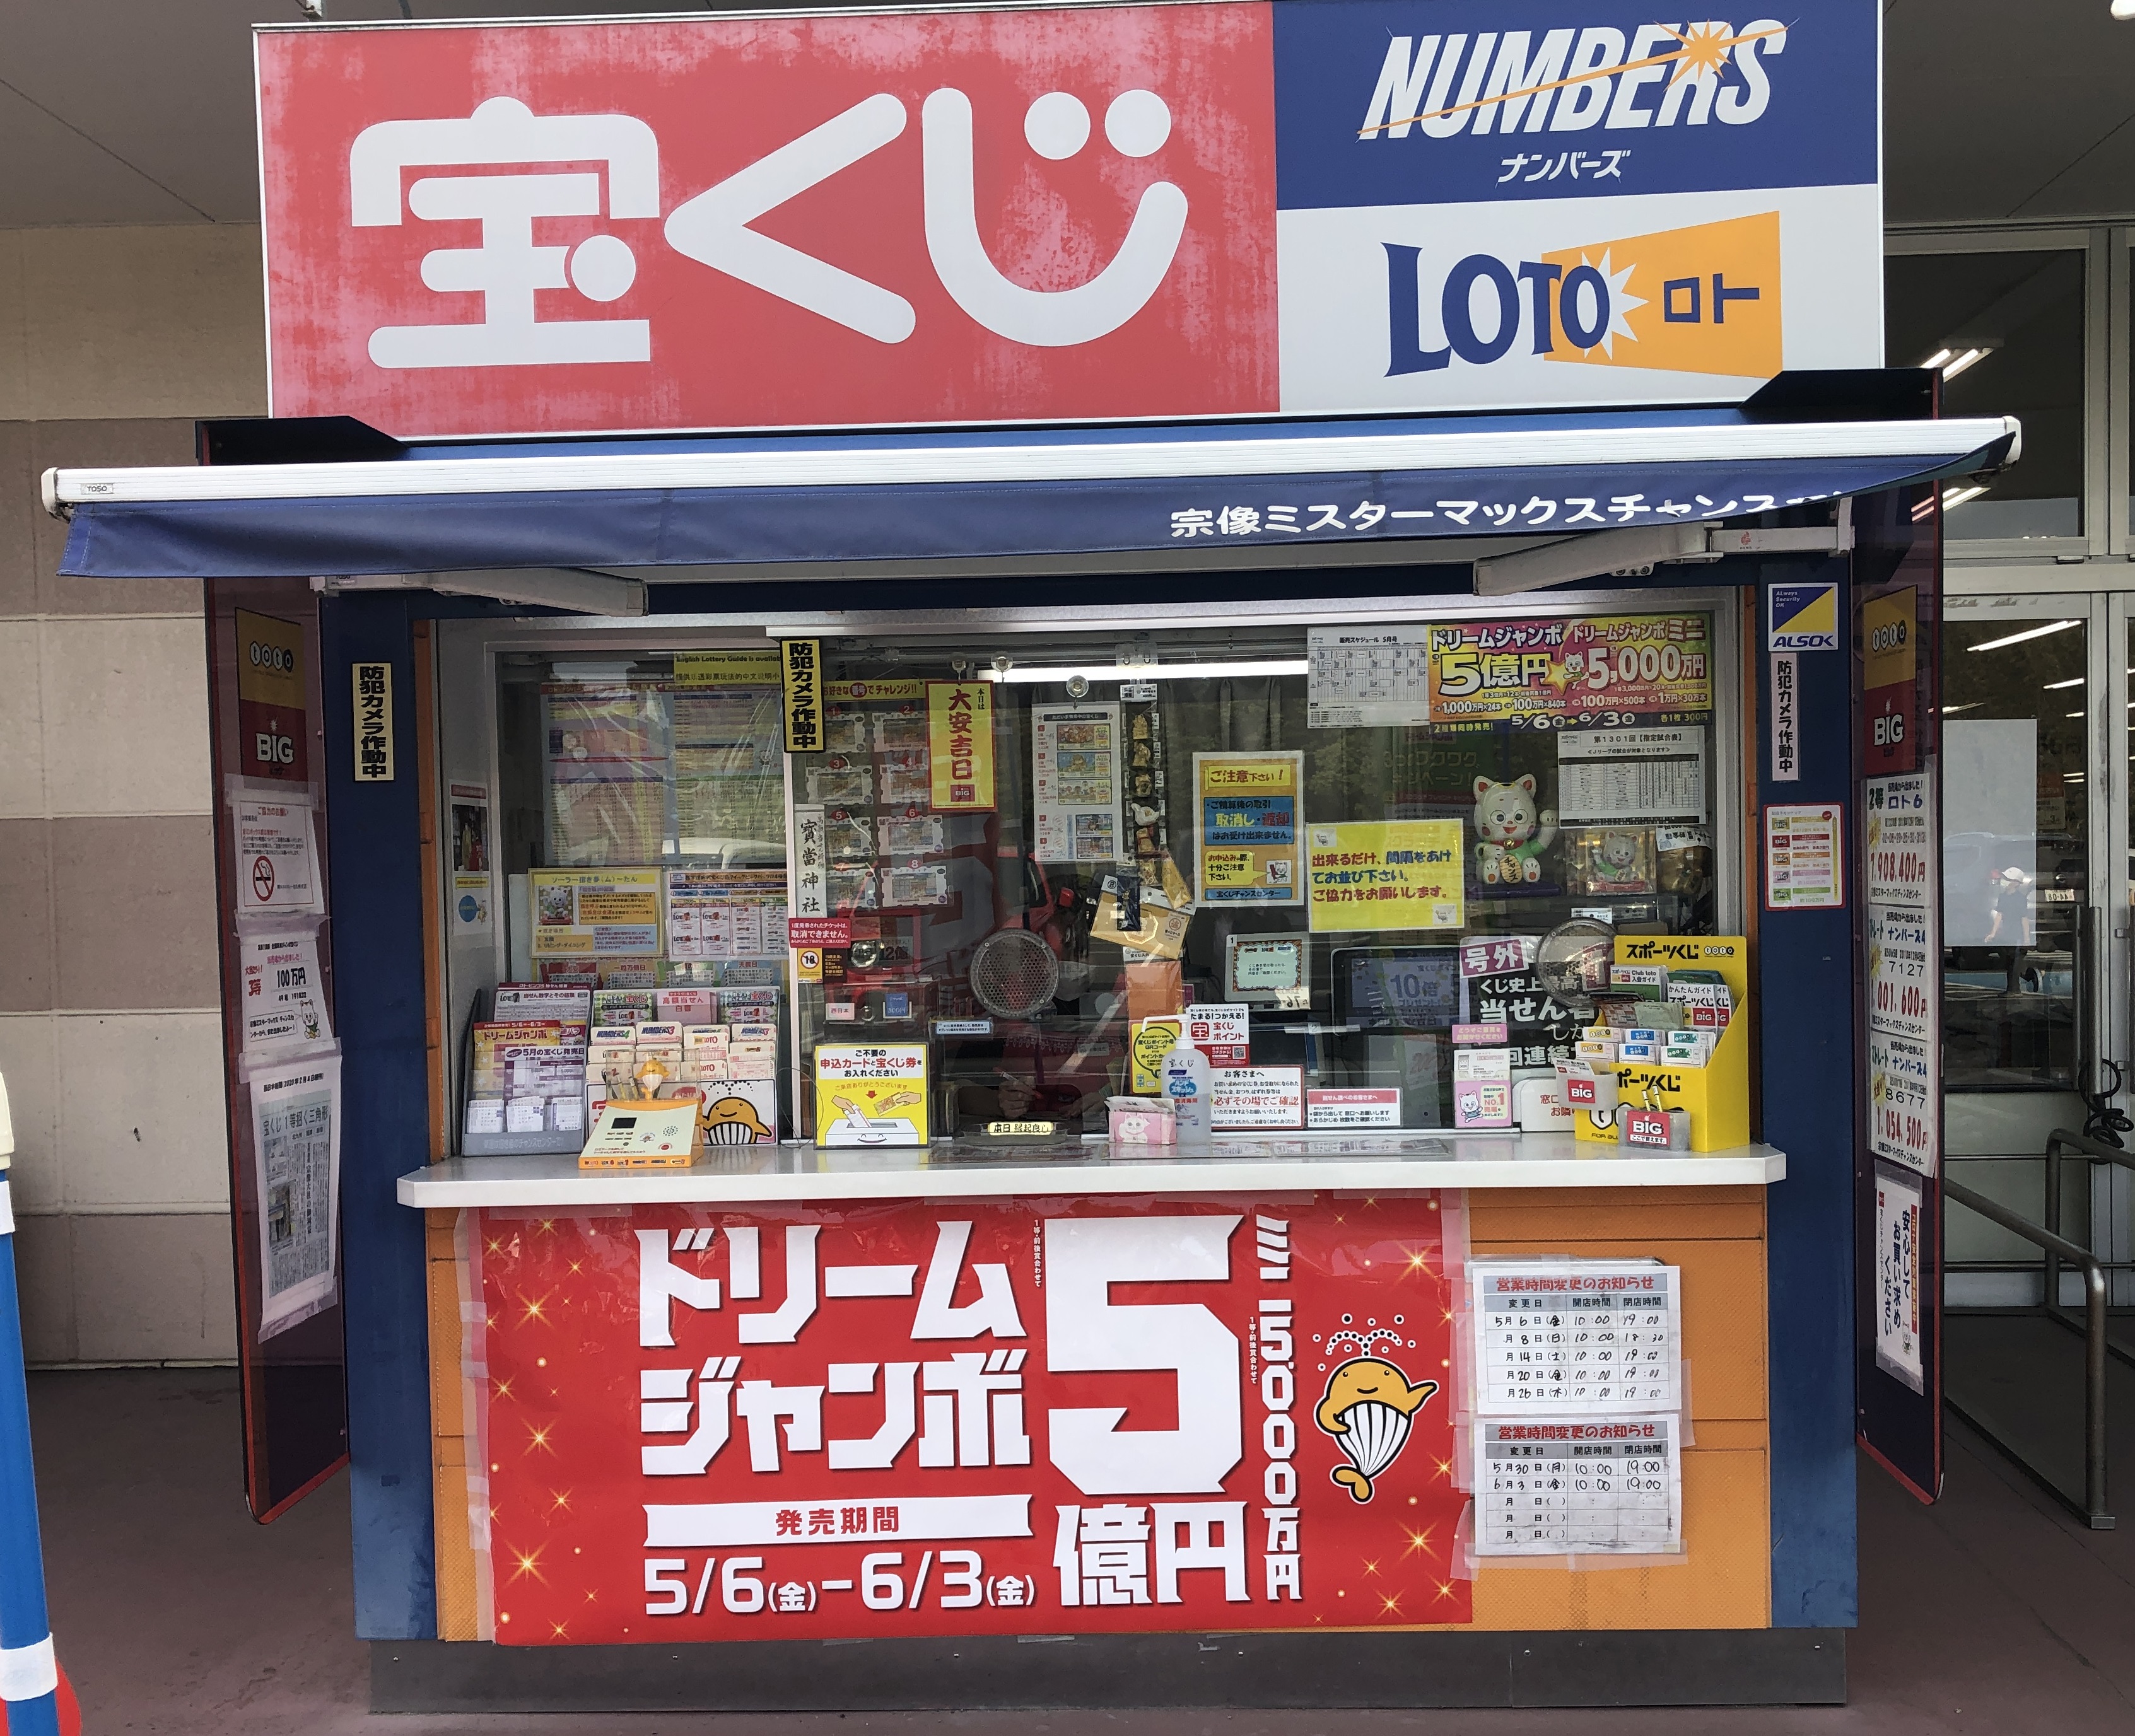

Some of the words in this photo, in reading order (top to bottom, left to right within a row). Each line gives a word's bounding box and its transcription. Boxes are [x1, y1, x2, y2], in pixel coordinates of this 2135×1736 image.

[1359, 19, 1789, 141] NUMBERS
[1499, 149, 1632, 183] ナンバーズ
[350, 87, 1189, 368] 宝くじ
[1663, 274, 1760, 324] ロト
[1383, 242, 1611, 377] LOTO
[1171, 493, 1842, 538] 宗像ミスターマックスチャンス
[1432, 624, 1563, 651] ドリームジャンボ
[1573, 619, 1704, 643] ドリームジャンボミニ
[1772, 635, 1834, 648] ALSOK
[1439, 651, 1552, 696] 5億円
[1588, 644, 1704, 689] 5,000万円
[789, 643, 816, 749] 防犯カメラ作動中
[977, 688, 985, 710] 本日は
[904, 706, 910, 714] 2
[1777, 660, 1794, 773] 防犯カメラ作動中
[359, 665, 387, 779] 防犯カメラ作動中
[1660, 714, 1681, 723] 各1枚
[1684, 713, 1708, 721] 300円
[948, 689, 973, 780] 大安吉日
[1873, 716, 1904, 746] BIG
[256, 733, 294, 764] BIG
[1210, 769, 1284, 783] ご注意下さい!
[955, 788, 970, 796] BIG
[1869, 786, 1885, 810] 2等
[1888, 795, 1923, 810] ロト6
[836, 811, 843, 820] 5
[909, 808, 916, 817] 6
[1215, 812, 1290, 827] 取消し・返却
[1212, 830, 1292, 841] はお受け出来ません。
[1312, 849, 1451, 868] 出来るだけ、間隔をあけ
[1208, 873, 1232, 881] 下さい。
[1312, 869, 1409, 884] てお並び下さい。
[1216, 890, 1280, 899] 宝くじチャンスセンター
[1313, 885, 1447, 902] ご協力をお願いします。
[791, 930, 848, 938] 取消できません。
[1465, 943, 1519, 972] 号外
[1626, 940, 1699, 960] スポーツくじ
[1704, 946, 1734, 955] toto
[1888, 960, 1924, 977] 7127
[277, 967, 307, 989] 100万円
[750, 992, 773, 1001] 宝くじ
[1668, 986, 1711, 994] かんたんガイド
[1669, 996, 1714, 1007] スポーツくじ
[1696, 1011, 1712, 1021] BIG
[1213, 1022, 1234, 1030] 宝くじ
[484, 1030, 547, 1040] ドリームジャンボ
[1213, 1032, 1244, 1040] ポイント
[821, 1057, 922, 1069] 申込カードと宝くじ券を
[1169, 1058, 1195, 1068] 宝くじ
[835, 1081, 908, 1091] ご来店ありがとうございます
[1571, 1088, 1593, 1098] BIG
[1214, 1096, 1299, 1106] 必ずその場でご確認
[1885, 1088, 1926, 1109] 8677
[994, 1123, 1010, 1133] 本日
[1632, 1121, 1663, 1135] BIG
[1631, 1134, 1665, 1143] ここで買えます。
[1893, 1220, 1902, 1329] お買い求め
[633, 1220, 1027, 1347] ドリーム
[1496, 1276, 1654, 1291] 営業時間変更のお知らせ
[1508, 1298, 1543, 1308] 変更日
[1572, 1296, 1611, 1307] 開店時間
[1623, 1296, 1661, 1307] 閉店時間
[1044, 1215, 1244, 1494] 5
[640, 1348, 1031, 1476] ジャンボ
[1498, 1424, 1655, 1440] 営業時間変更のお知らせ
[1509, 1446, 1544, 1456] 変更日
[1574, 1445, 1612, 1455] 開店時間
[1624, 1444, 1662, 1455] 閉店時間
[775, 1505, 900, 1536] 発売期間
[1053, 1501, 1251, 1606] 億円
